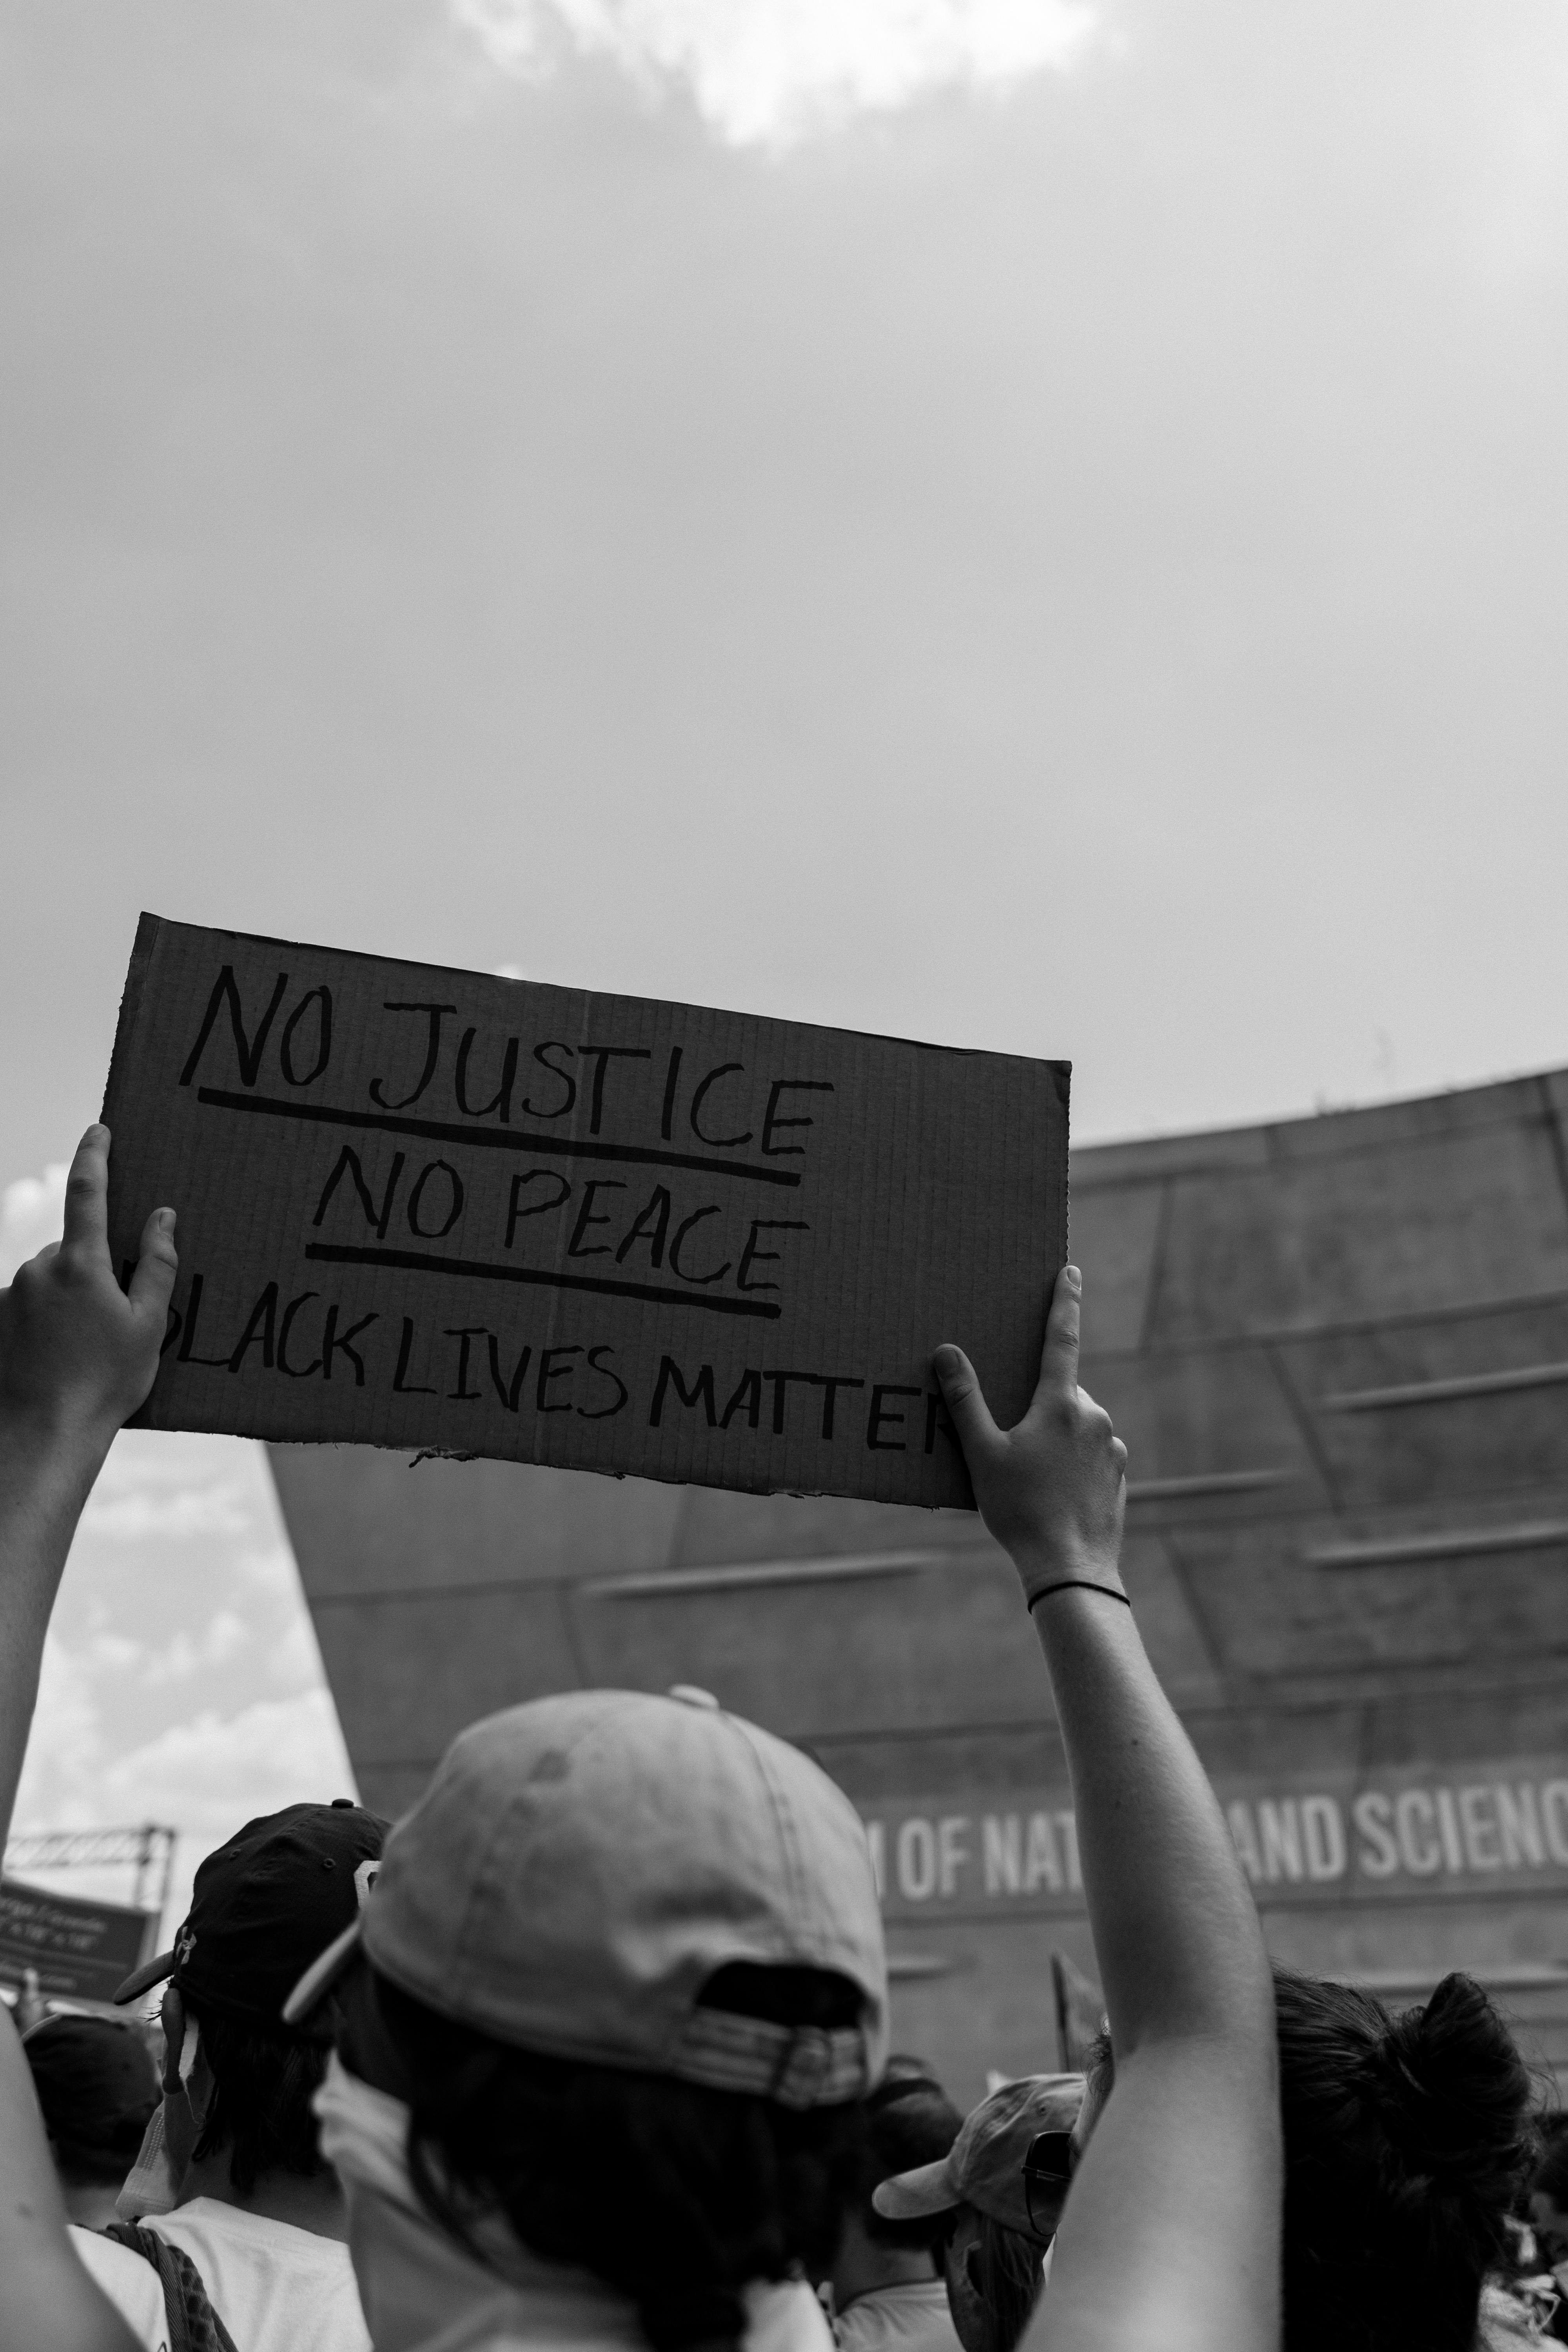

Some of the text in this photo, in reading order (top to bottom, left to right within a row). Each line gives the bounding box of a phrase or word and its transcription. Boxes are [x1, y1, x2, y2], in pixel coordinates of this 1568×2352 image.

[178, 965, 834, 1156] NO JUSTICE
[312, 1145, 810, 1291] NO PEACE
[392, 1316, 629, 1419] LIVES
[897, 1817, 971, 1899] OF
[982, 1809, 1083, 1898] NAT
